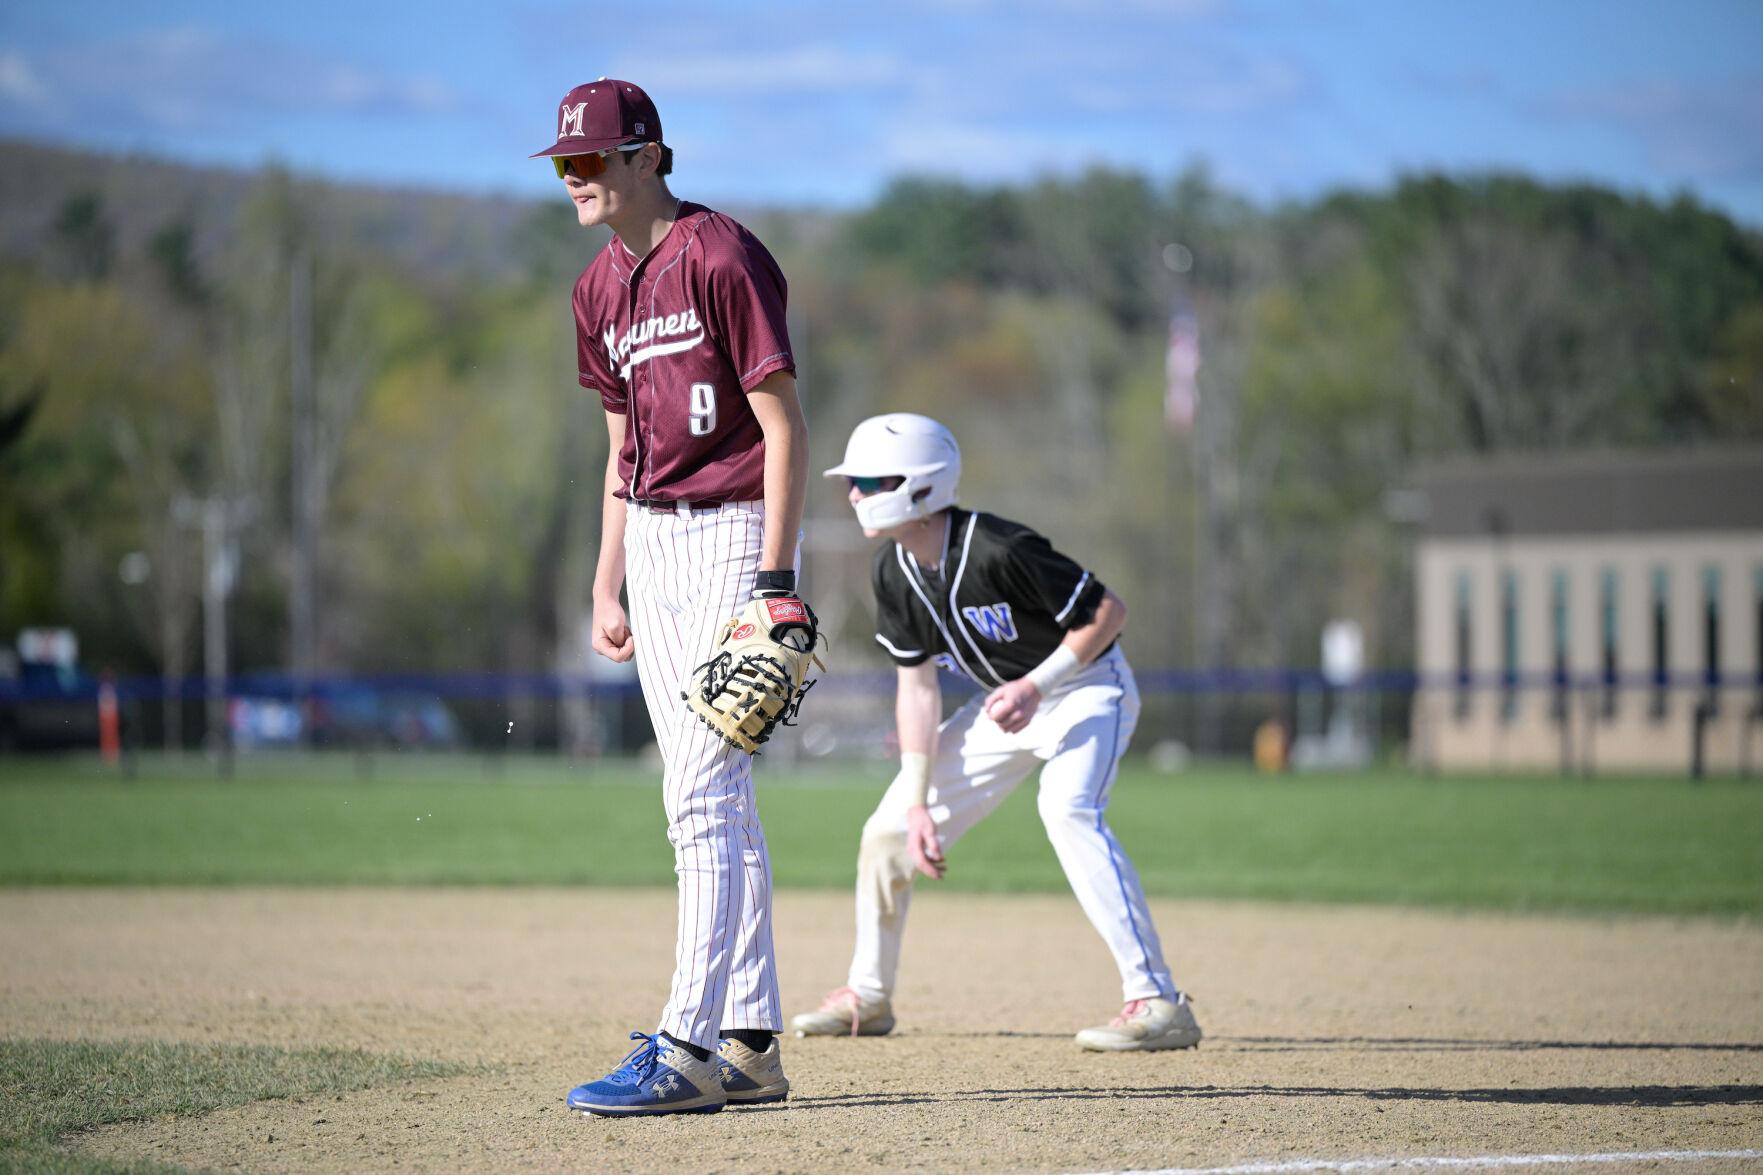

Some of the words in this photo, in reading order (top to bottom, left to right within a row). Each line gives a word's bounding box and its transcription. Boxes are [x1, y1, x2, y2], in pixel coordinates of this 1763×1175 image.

[558, 102, 588, 139] M
[689, 383, 716, 436] 9
[962, 603, 1018, 642] W
